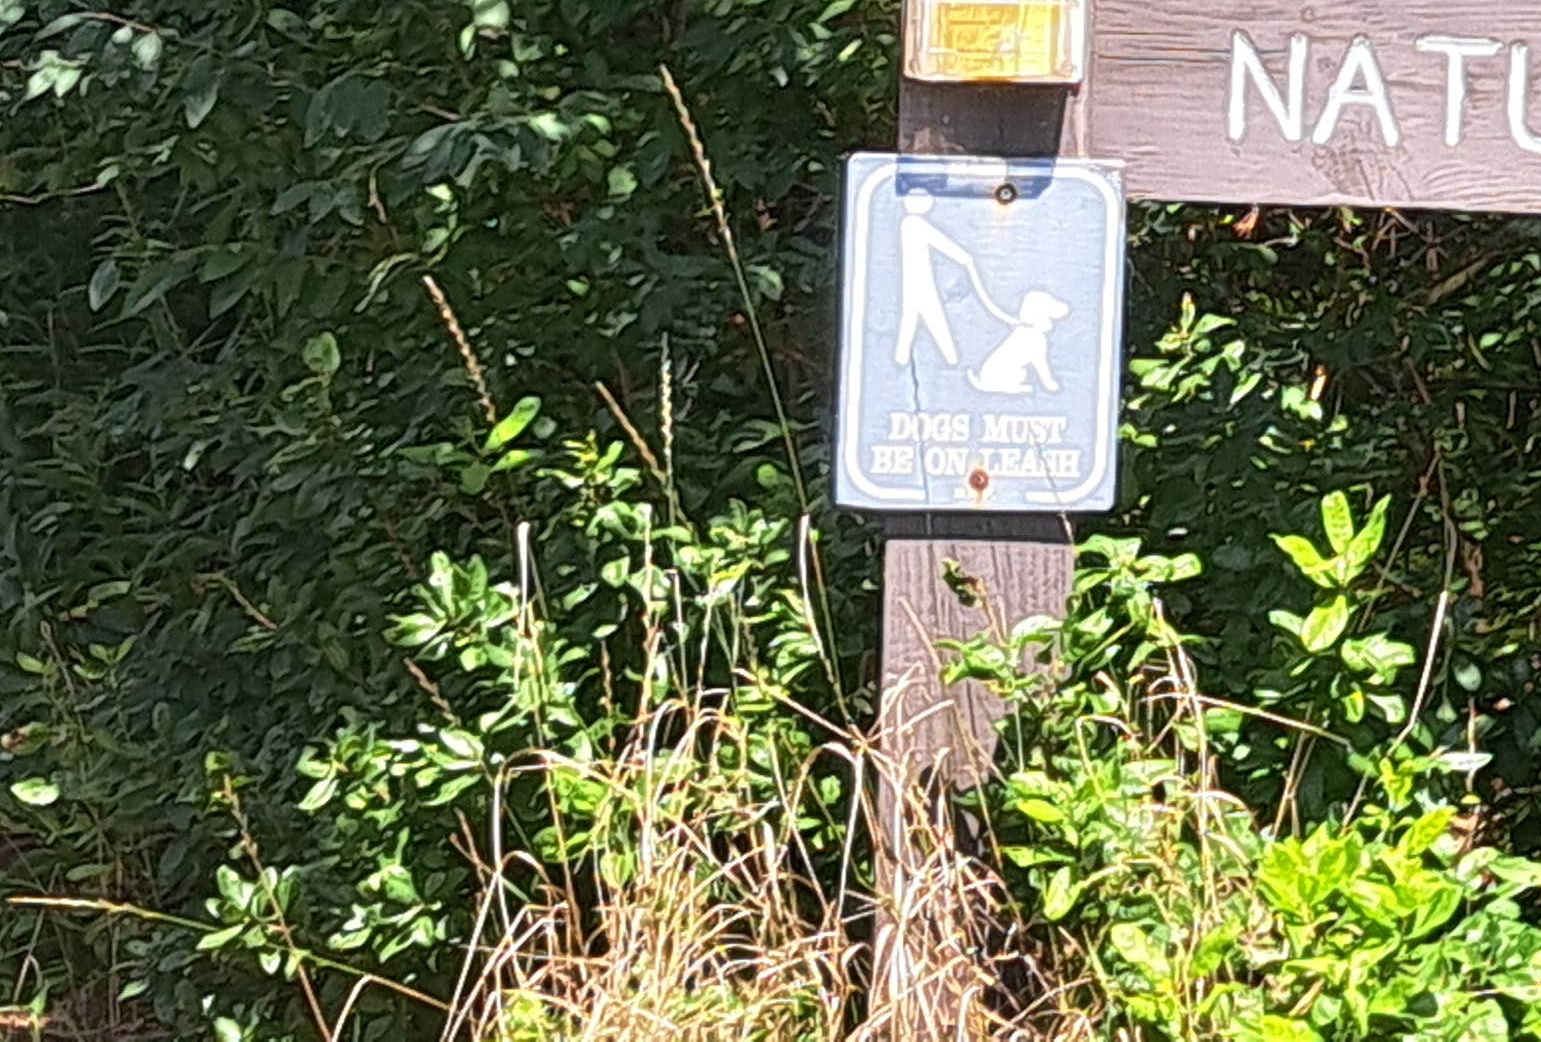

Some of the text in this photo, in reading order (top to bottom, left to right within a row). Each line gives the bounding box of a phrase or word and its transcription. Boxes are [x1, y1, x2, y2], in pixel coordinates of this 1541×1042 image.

[888, 412, 1067, 444] DOGS MUST
[870, 444, 1081, 479] BE ON LEASH
